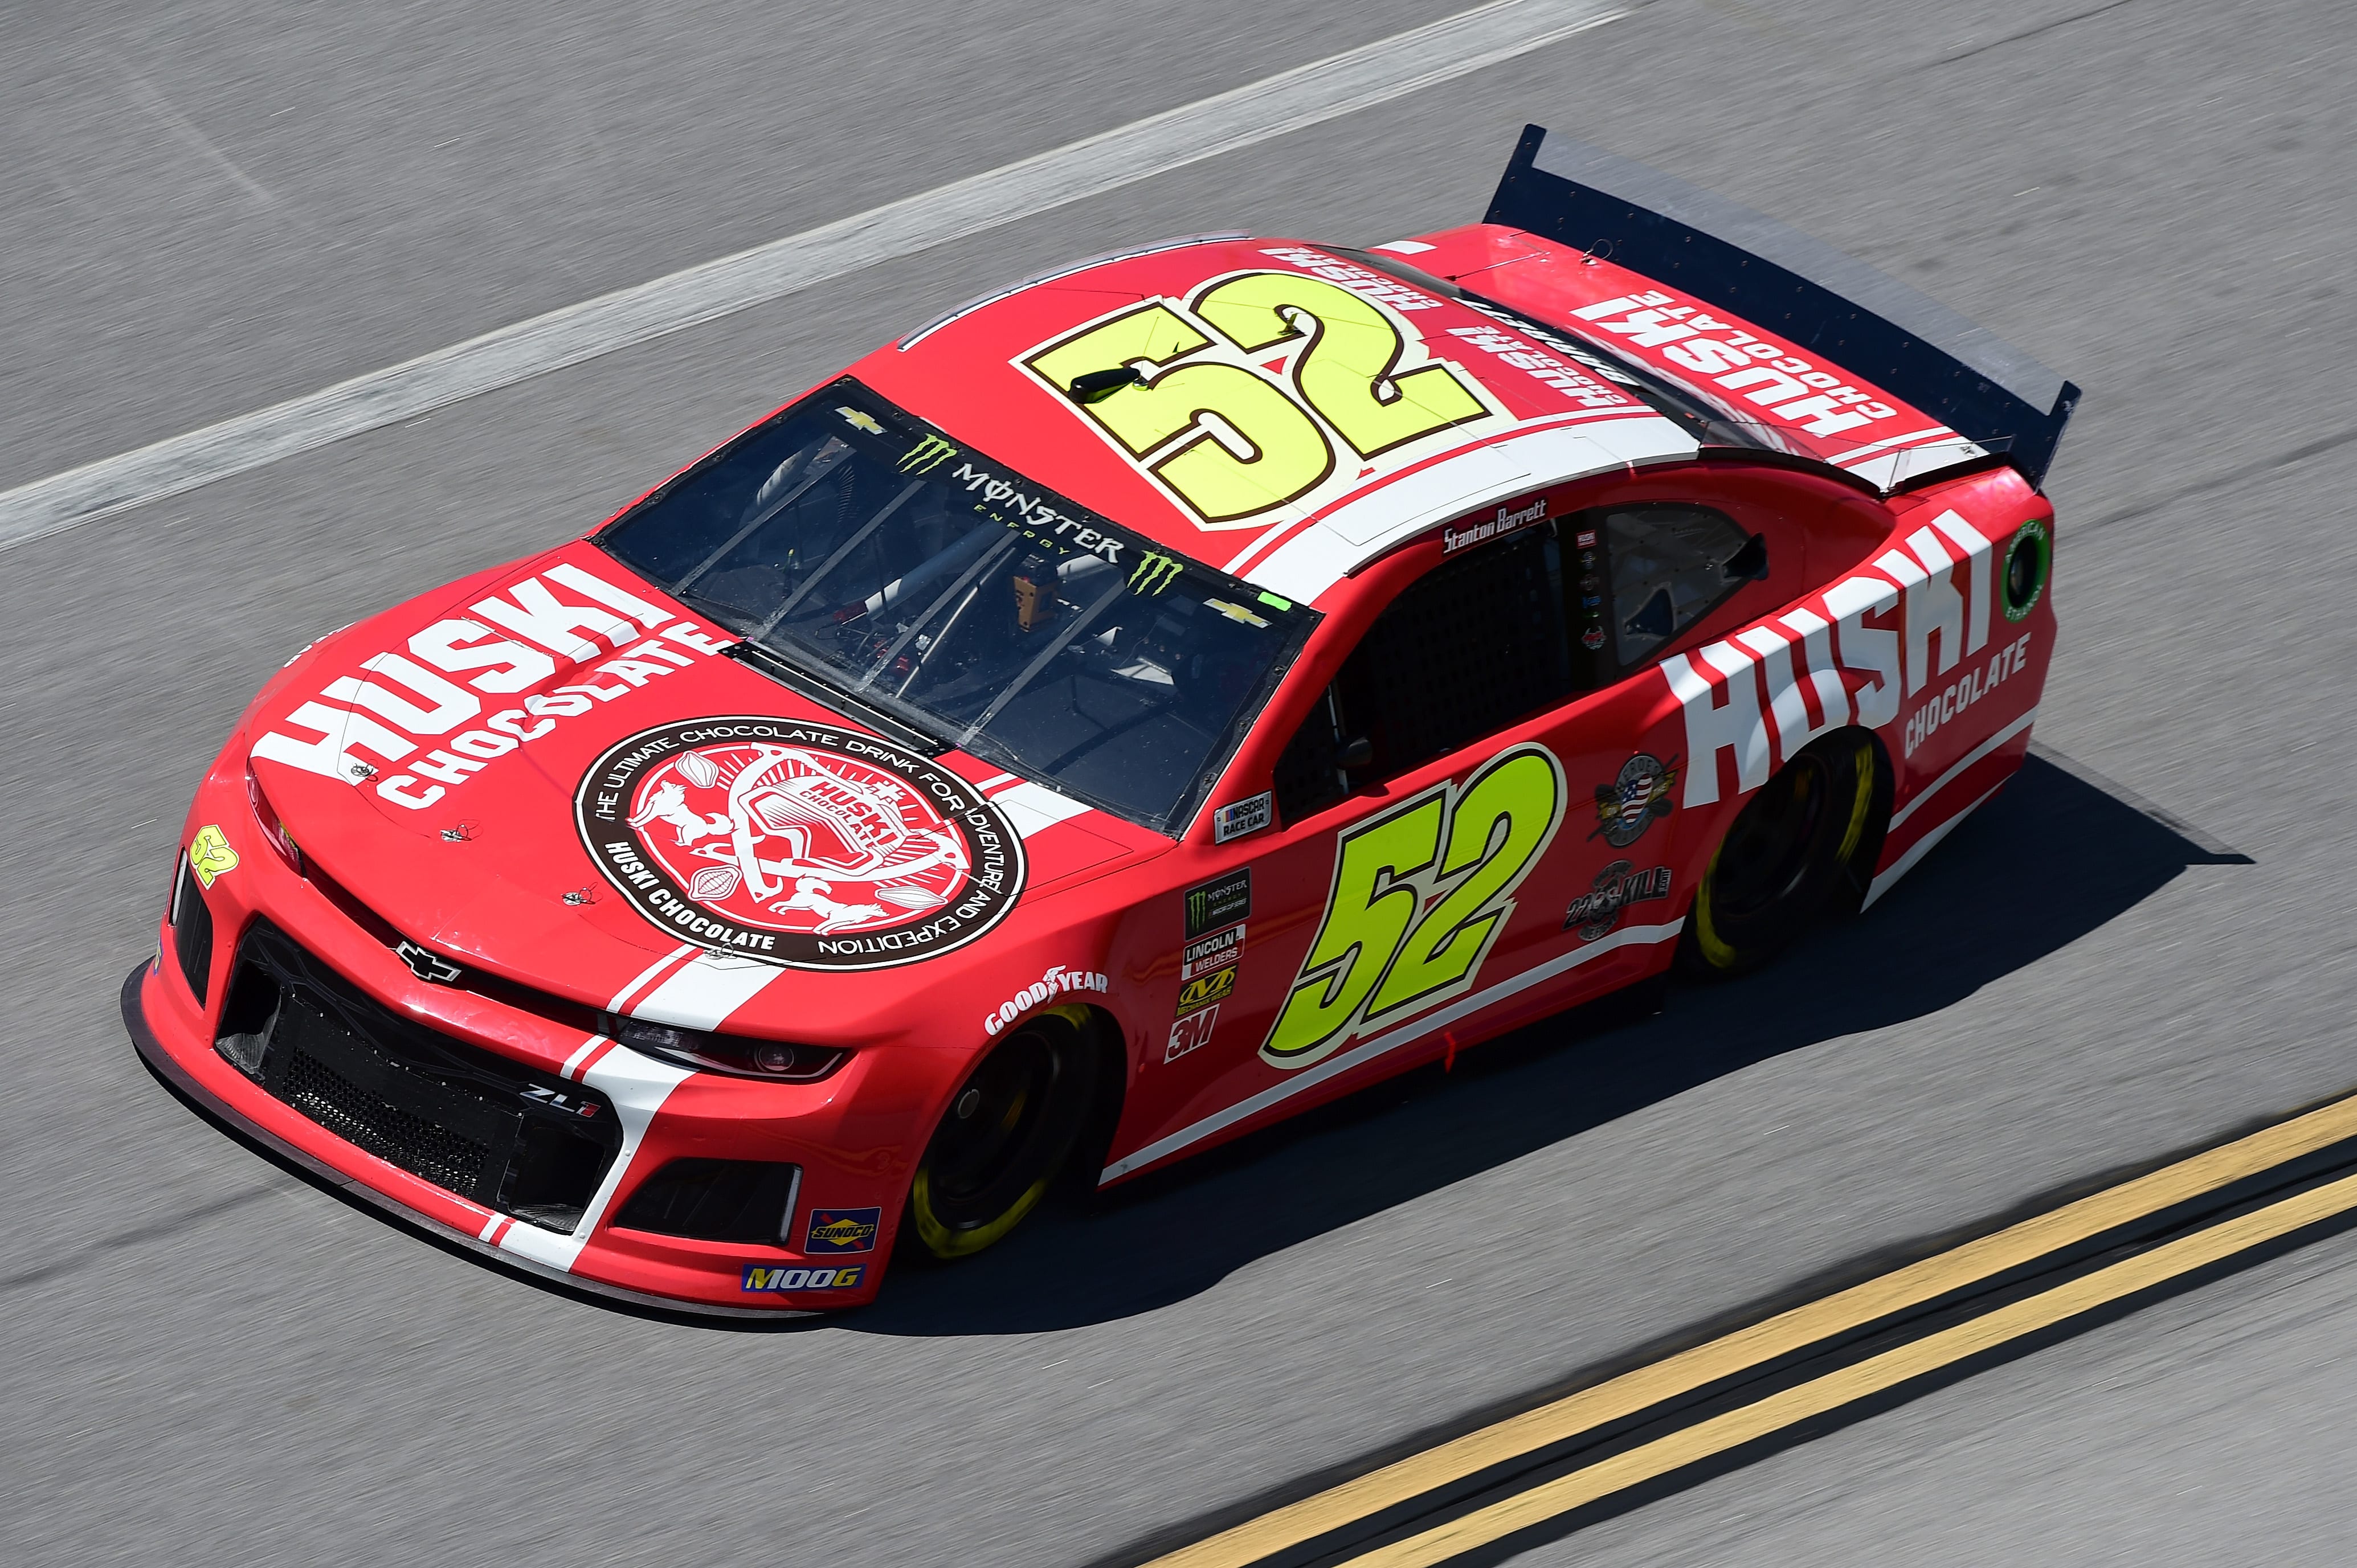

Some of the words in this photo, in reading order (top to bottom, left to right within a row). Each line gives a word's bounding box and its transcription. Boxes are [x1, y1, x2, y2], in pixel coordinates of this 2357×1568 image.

[1257, 248, 1431, 310] HUSKI
[1445, 327, 1616, 407] HUSKI
[1568, 296, 1873, 439] HUSKI
[1631, 290, 1898, 419] CHOCOLATE
[1021, 271, 1494, 524] 52
[973, 504, 1071, 555] ENERGY
[1443, 524, 1496, 554] Stanton
[1496, 500, 1547, 533] Barrett
[249, 563, 676, 787] HUSKI
[1659, 509, 1993, 809] HUSKI
[376, 621, 733, 810] CHOCOLATE
[1905, 632, 2032, 759] CHOCOLATE
[603, 737, 680, 788] ULTIMATE
[680, 726, 838, 746] CHOCOLATE
[845, 740, 920, 773] DRINK
[808, 781, 898, 845] HUSKI
[918, 772, 966, 812] FOR
[1233, 797, 1264, 819] NASCAR
[799, 791, 878, 849] CHOCOLATE
[1224, 820, 1245, 837] RACE
[1248, 813, 1264, 827] CAR
[190, 825, 239, 888] 52
[964, 807, 1004, 894] ADVENTURE
[604, 841, 659, 890] HUSKI
[648, 889, 775, 950] CHOCOLATE
[955, 890, 992, 918] AND
[1263, 748, 1558, 1058] 52
[818, 915, 961, 954] EXPEDITION
[1186, 931, 1234, 963] LINCOLN
[1195, 947, 1238, 972] WELDERS
[1168, 1005, 1218, 1059] 3M
[519, 1083, 601, 1118] ZL1
[811, 1225, 873, 1239] SUNOCO
[745, 1267, 862, 1289] MOOG
